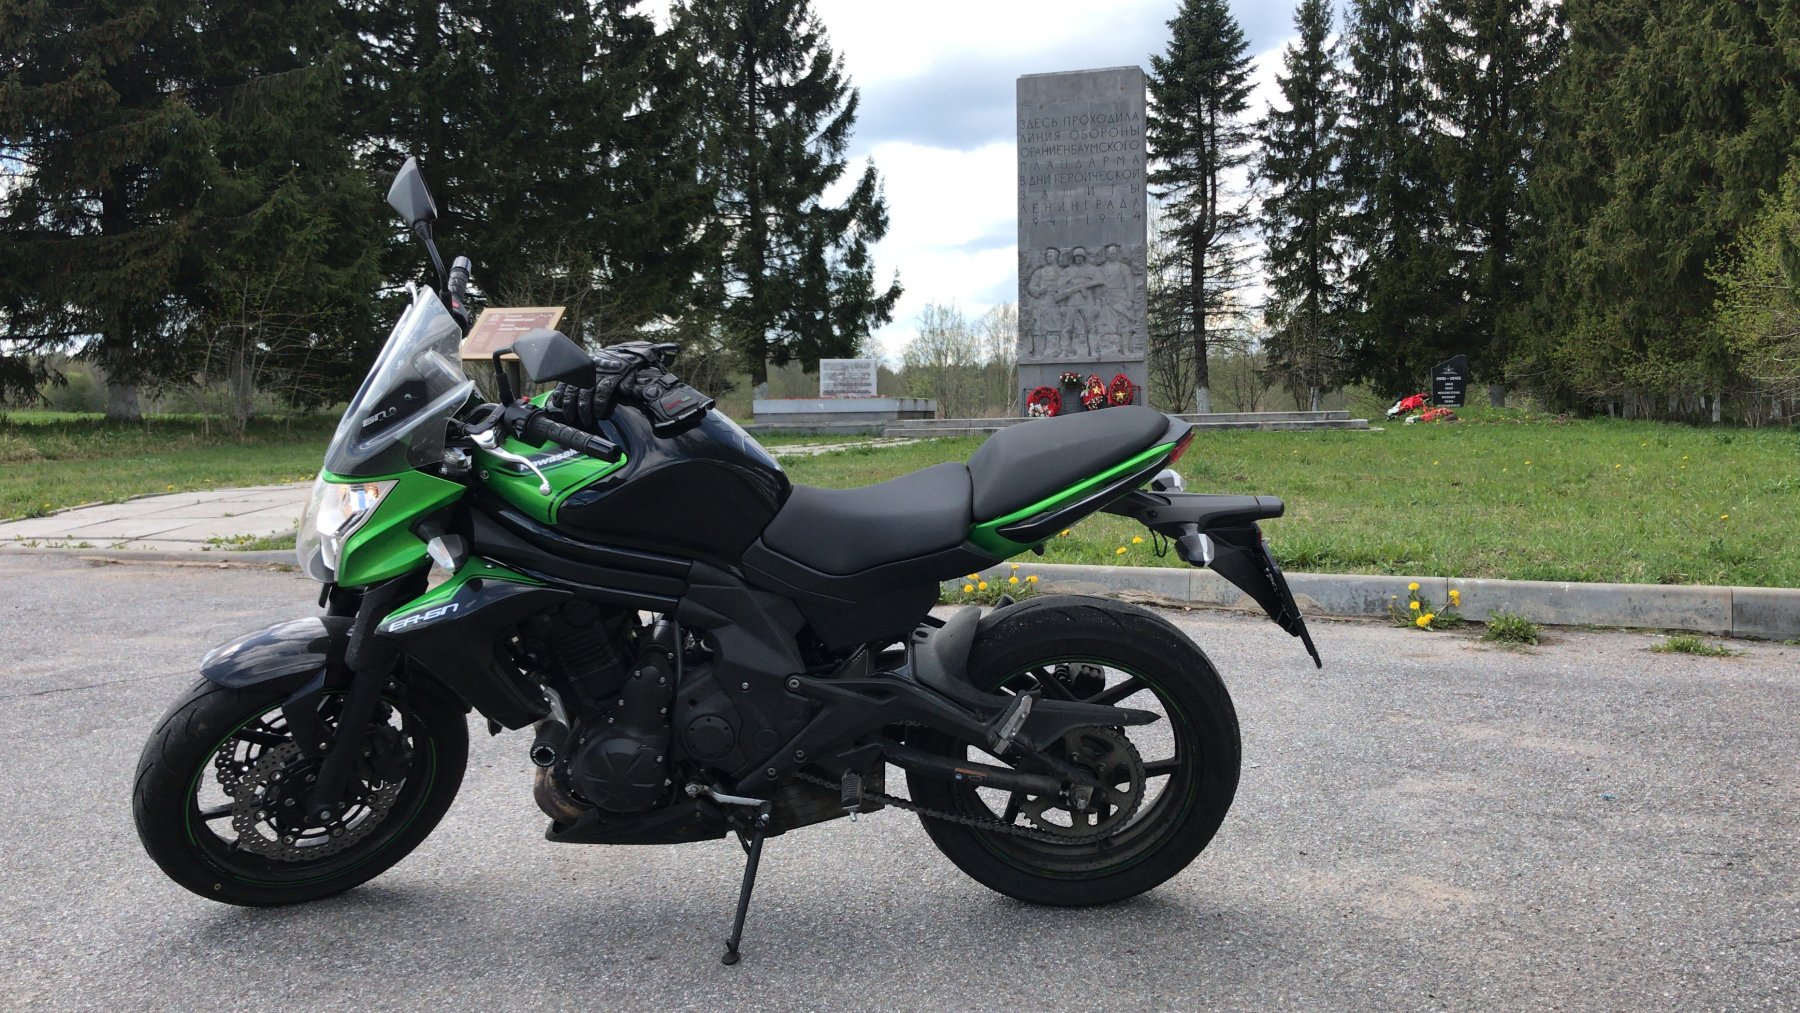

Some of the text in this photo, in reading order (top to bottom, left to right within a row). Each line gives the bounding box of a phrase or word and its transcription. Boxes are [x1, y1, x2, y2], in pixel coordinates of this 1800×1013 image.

[1020, 112, 1139, 129] ЗДЕСЬ ПРОХОДИЛА
[1020, 126, 1140, 143] ЛИНИЯ ОБОРОНЫ
[1020, 141, 1140, 158] ОРАНИЕНБАУМСКОГО
[1020, 155, 1139, 171] ПЛАЦДАРМА
[1020, 176, 1026, 186] В
[1029, 174, 1051, 186] ДНИ
[1020, 198, 1140, 214] ЛЕНИНГРАДА
[519, 448, 580, 471] Kawasak
